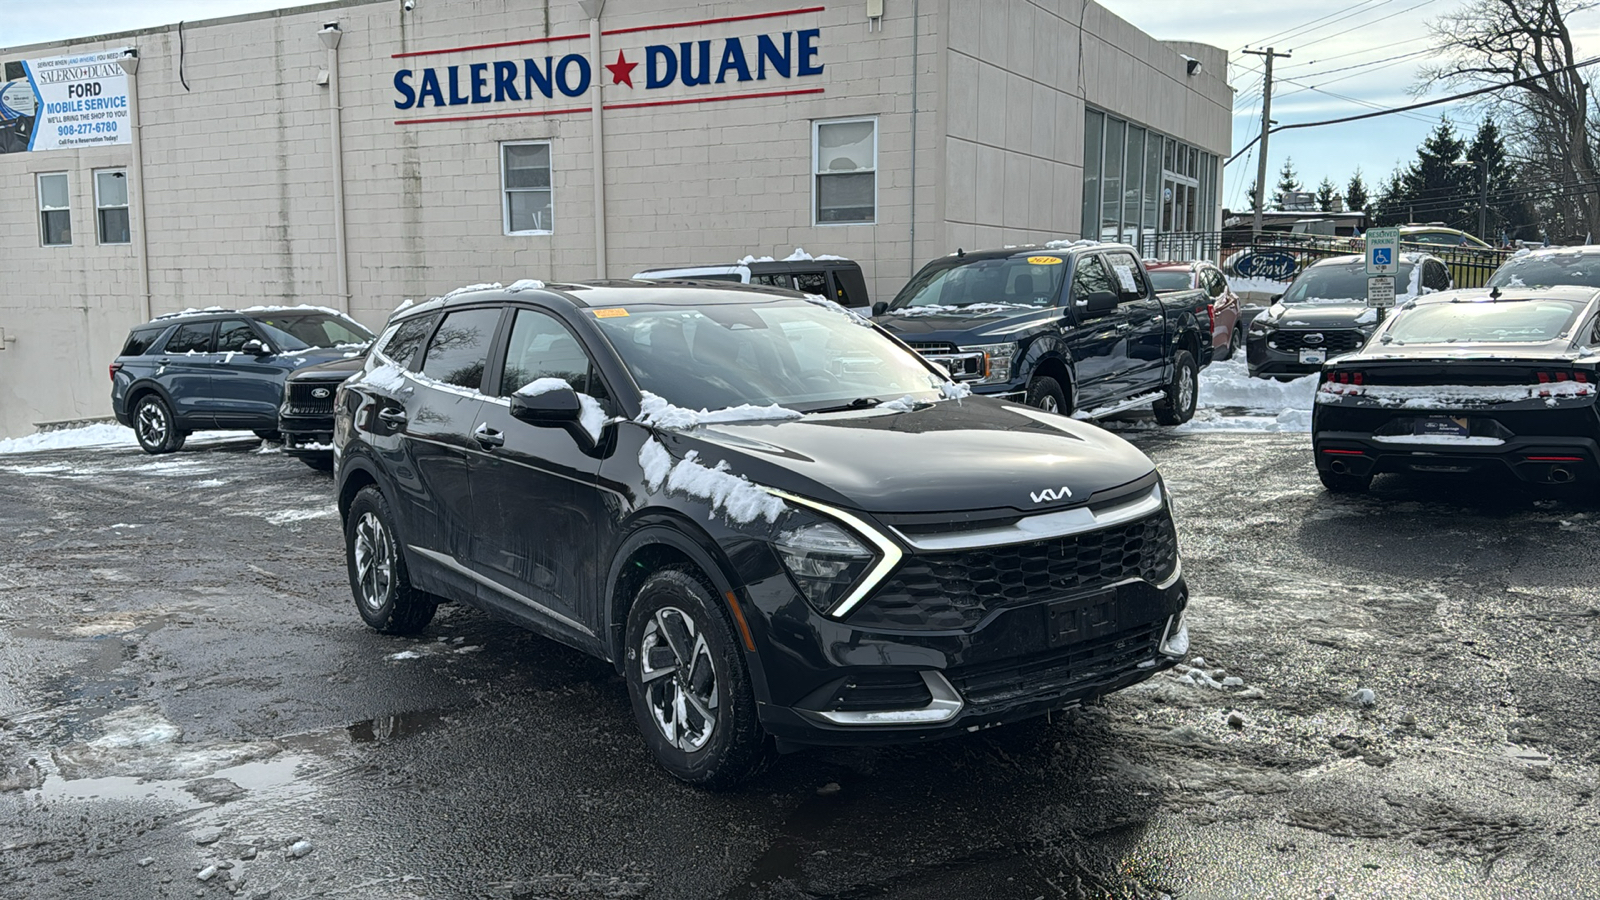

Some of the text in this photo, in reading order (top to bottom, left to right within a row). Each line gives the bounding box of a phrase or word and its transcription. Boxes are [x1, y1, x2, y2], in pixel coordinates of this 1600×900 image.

[37, 60, 54, 68] SERVICE
[54, 59, 68, 67] WHEN
[106, 52, 118, 60] NEED
[40, 63, 123, 83] SALERNO DUANE
[393, 28, 826, 110] SALERNO DUANE
[68, 82, 102, 98] FORD
[46, 100, 83, 114] MOBILE
[84, 96, 126, 111] SERVICE
[62, 114, 79, 122] BRING
[90, 112, 105, 120] SHOP
[58, 120, 118, 136] 908-277-6780
[1248, 256, 1288, 276] Ford
[1030, 486, 1072, 503] KIA
